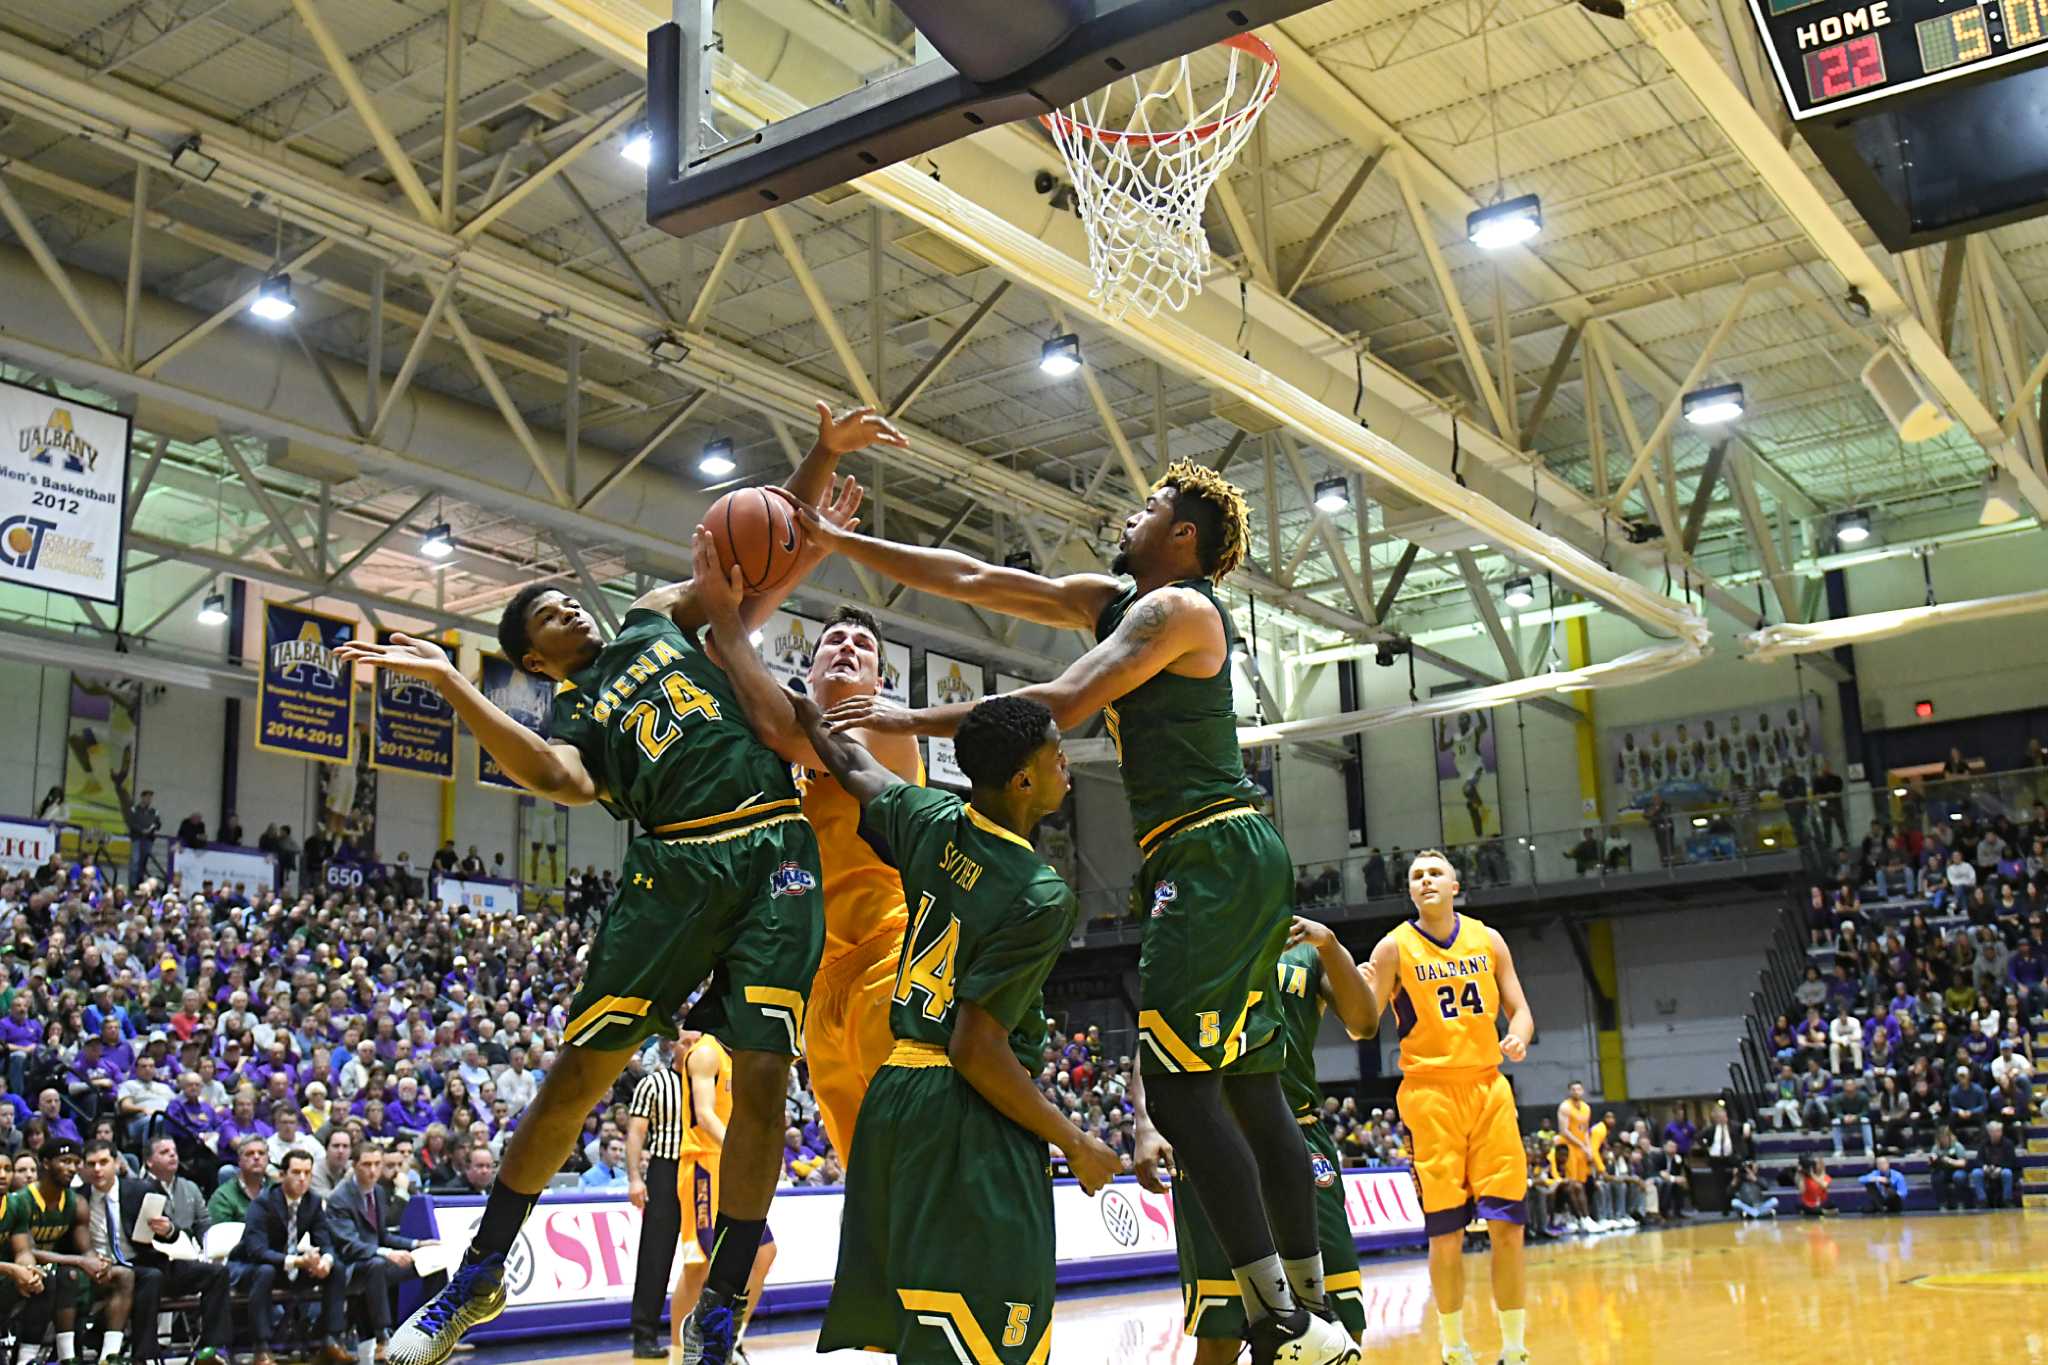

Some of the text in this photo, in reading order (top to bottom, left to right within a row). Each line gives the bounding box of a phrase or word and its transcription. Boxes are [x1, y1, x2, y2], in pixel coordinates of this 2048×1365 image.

[1796, 0, 1891, 49] HOME
[1818, 35, 1884, 97] 22
[19, 424, 98, 473] UALBANY
[32, 491, 80, 515] 2012
[41, 475, 116, 504] Basketball
[619, 670, 723, 763] 24
[266, 721, 344, 748] 2014-2015
[379, 741, 449, 765] 2013-2014
[327, 867, 363, 887] 650
[892, 890, 961, 1024] 14
[1415, 956, 1489, 982] UALBANY
[1436, 981, 1485, 1020] 24
